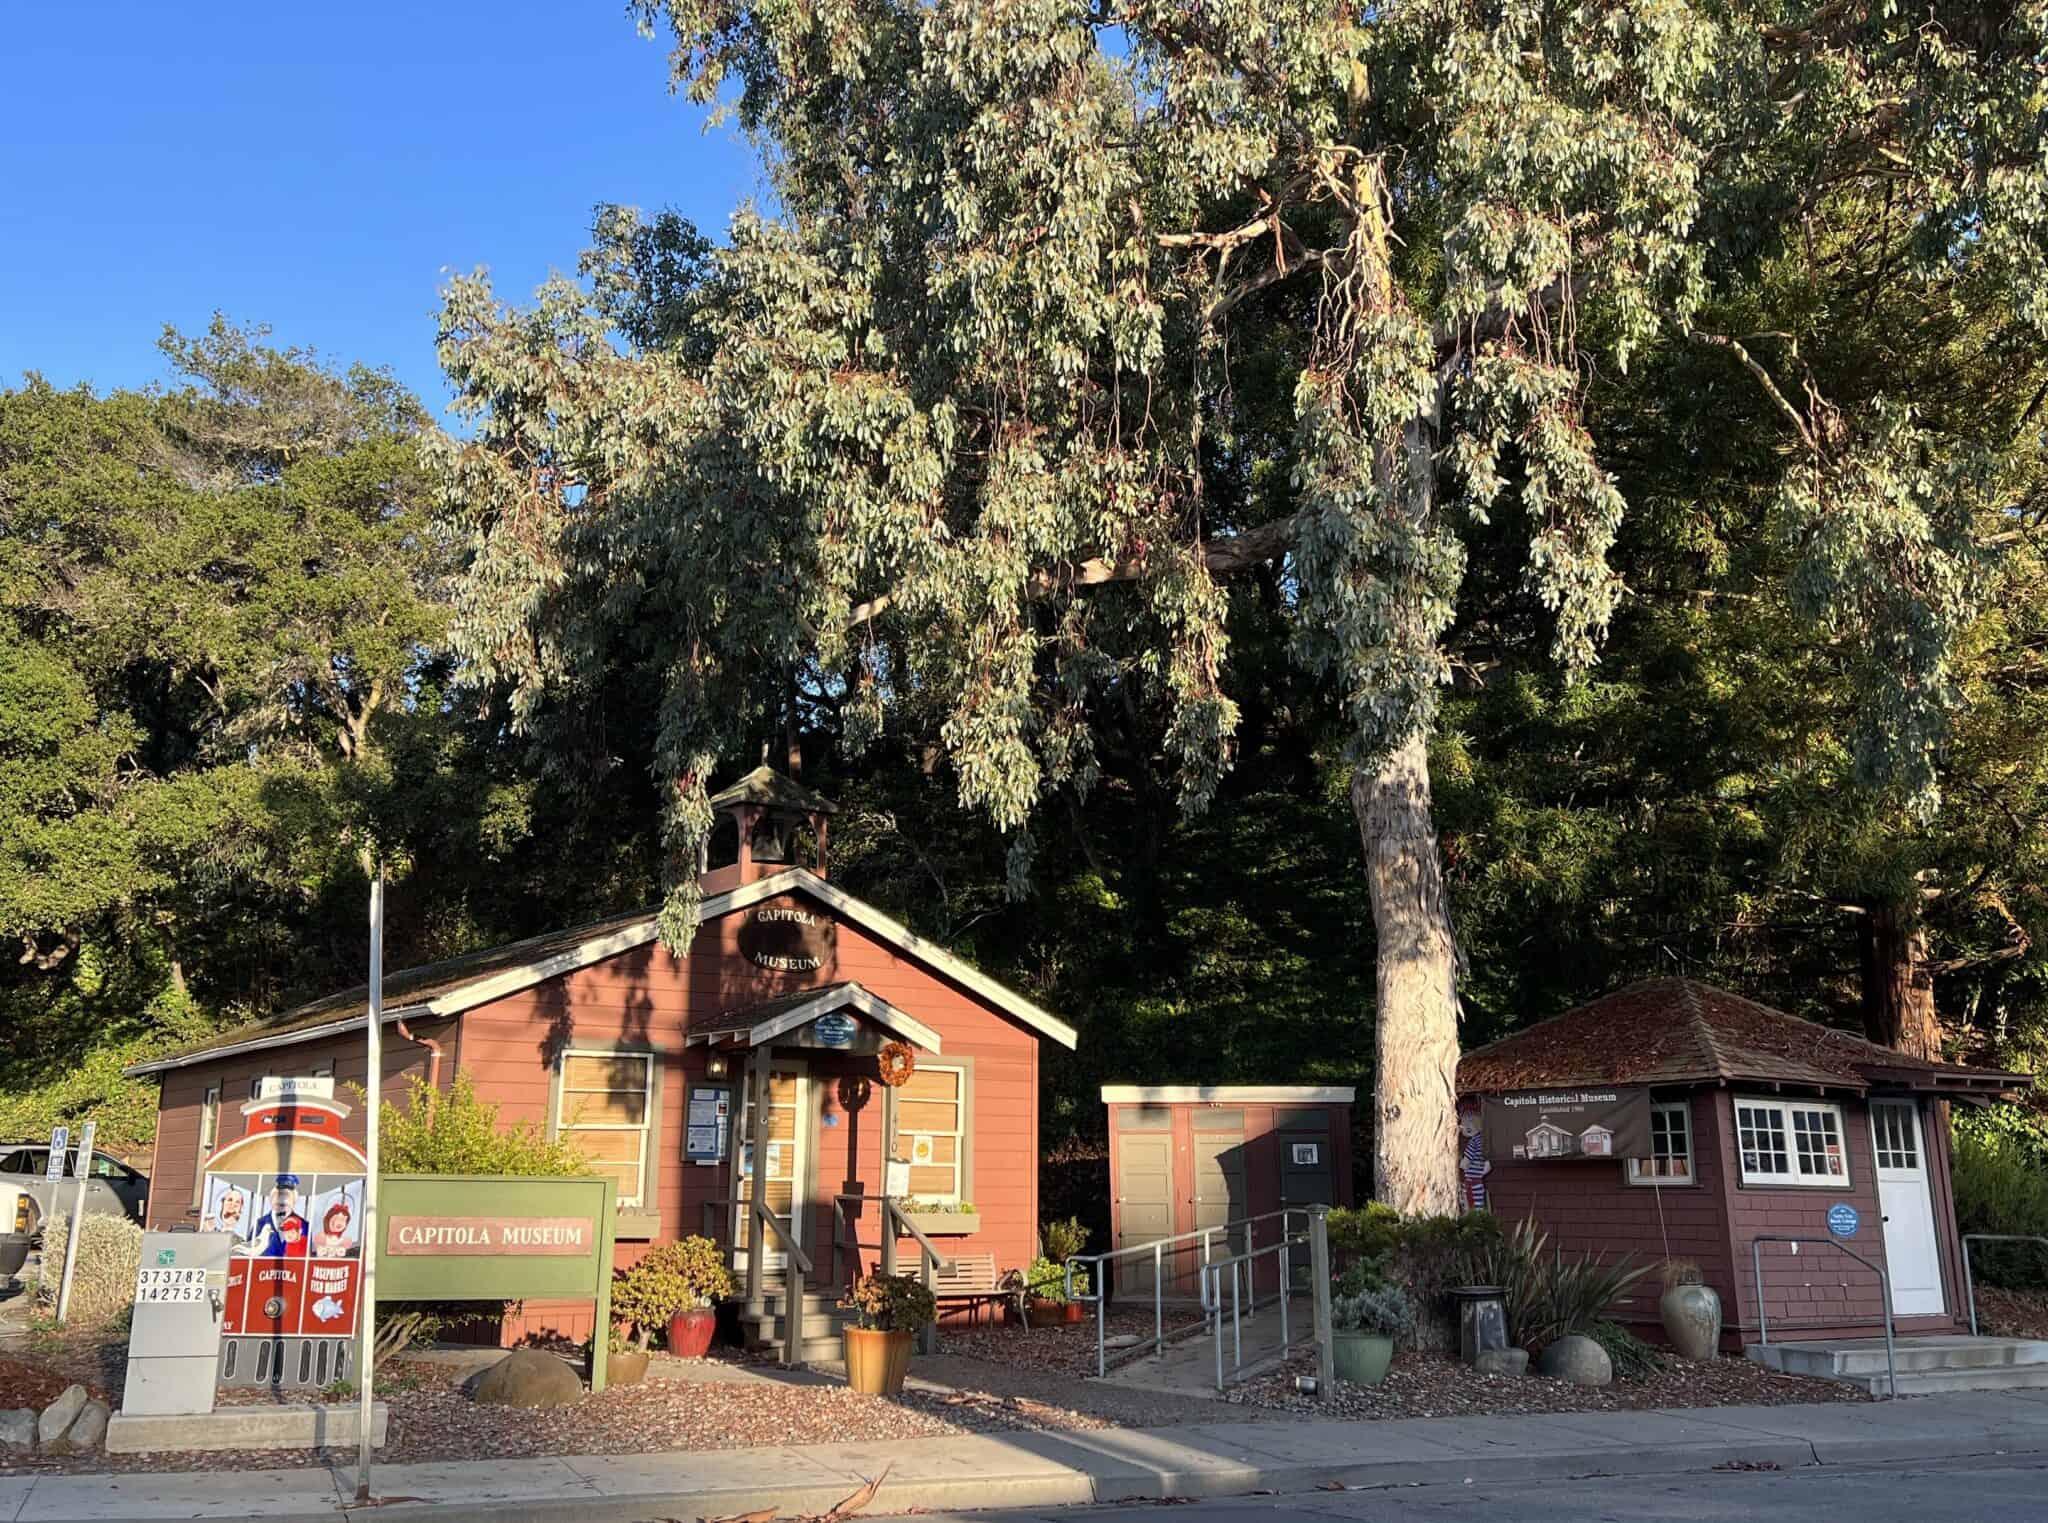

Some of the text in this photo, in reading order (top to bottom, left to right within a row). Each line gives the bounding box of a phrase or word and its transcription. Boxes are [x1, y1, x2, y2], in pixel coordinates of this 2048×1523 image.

[757, 909, 816, 927] CAPITOLA
[755, 951, 821, 970] MUSEUM
[1504, 1093, 1617, 1108] Capitola Historical Museum
[399, 1226, 582, 1245] CAPITOLA MUSEUM
[141, 1271, 205, 1284] 373782
[258, 1269, 297, 1283] CAPITOLA
[141, 1287, 203, 1301] 142752
